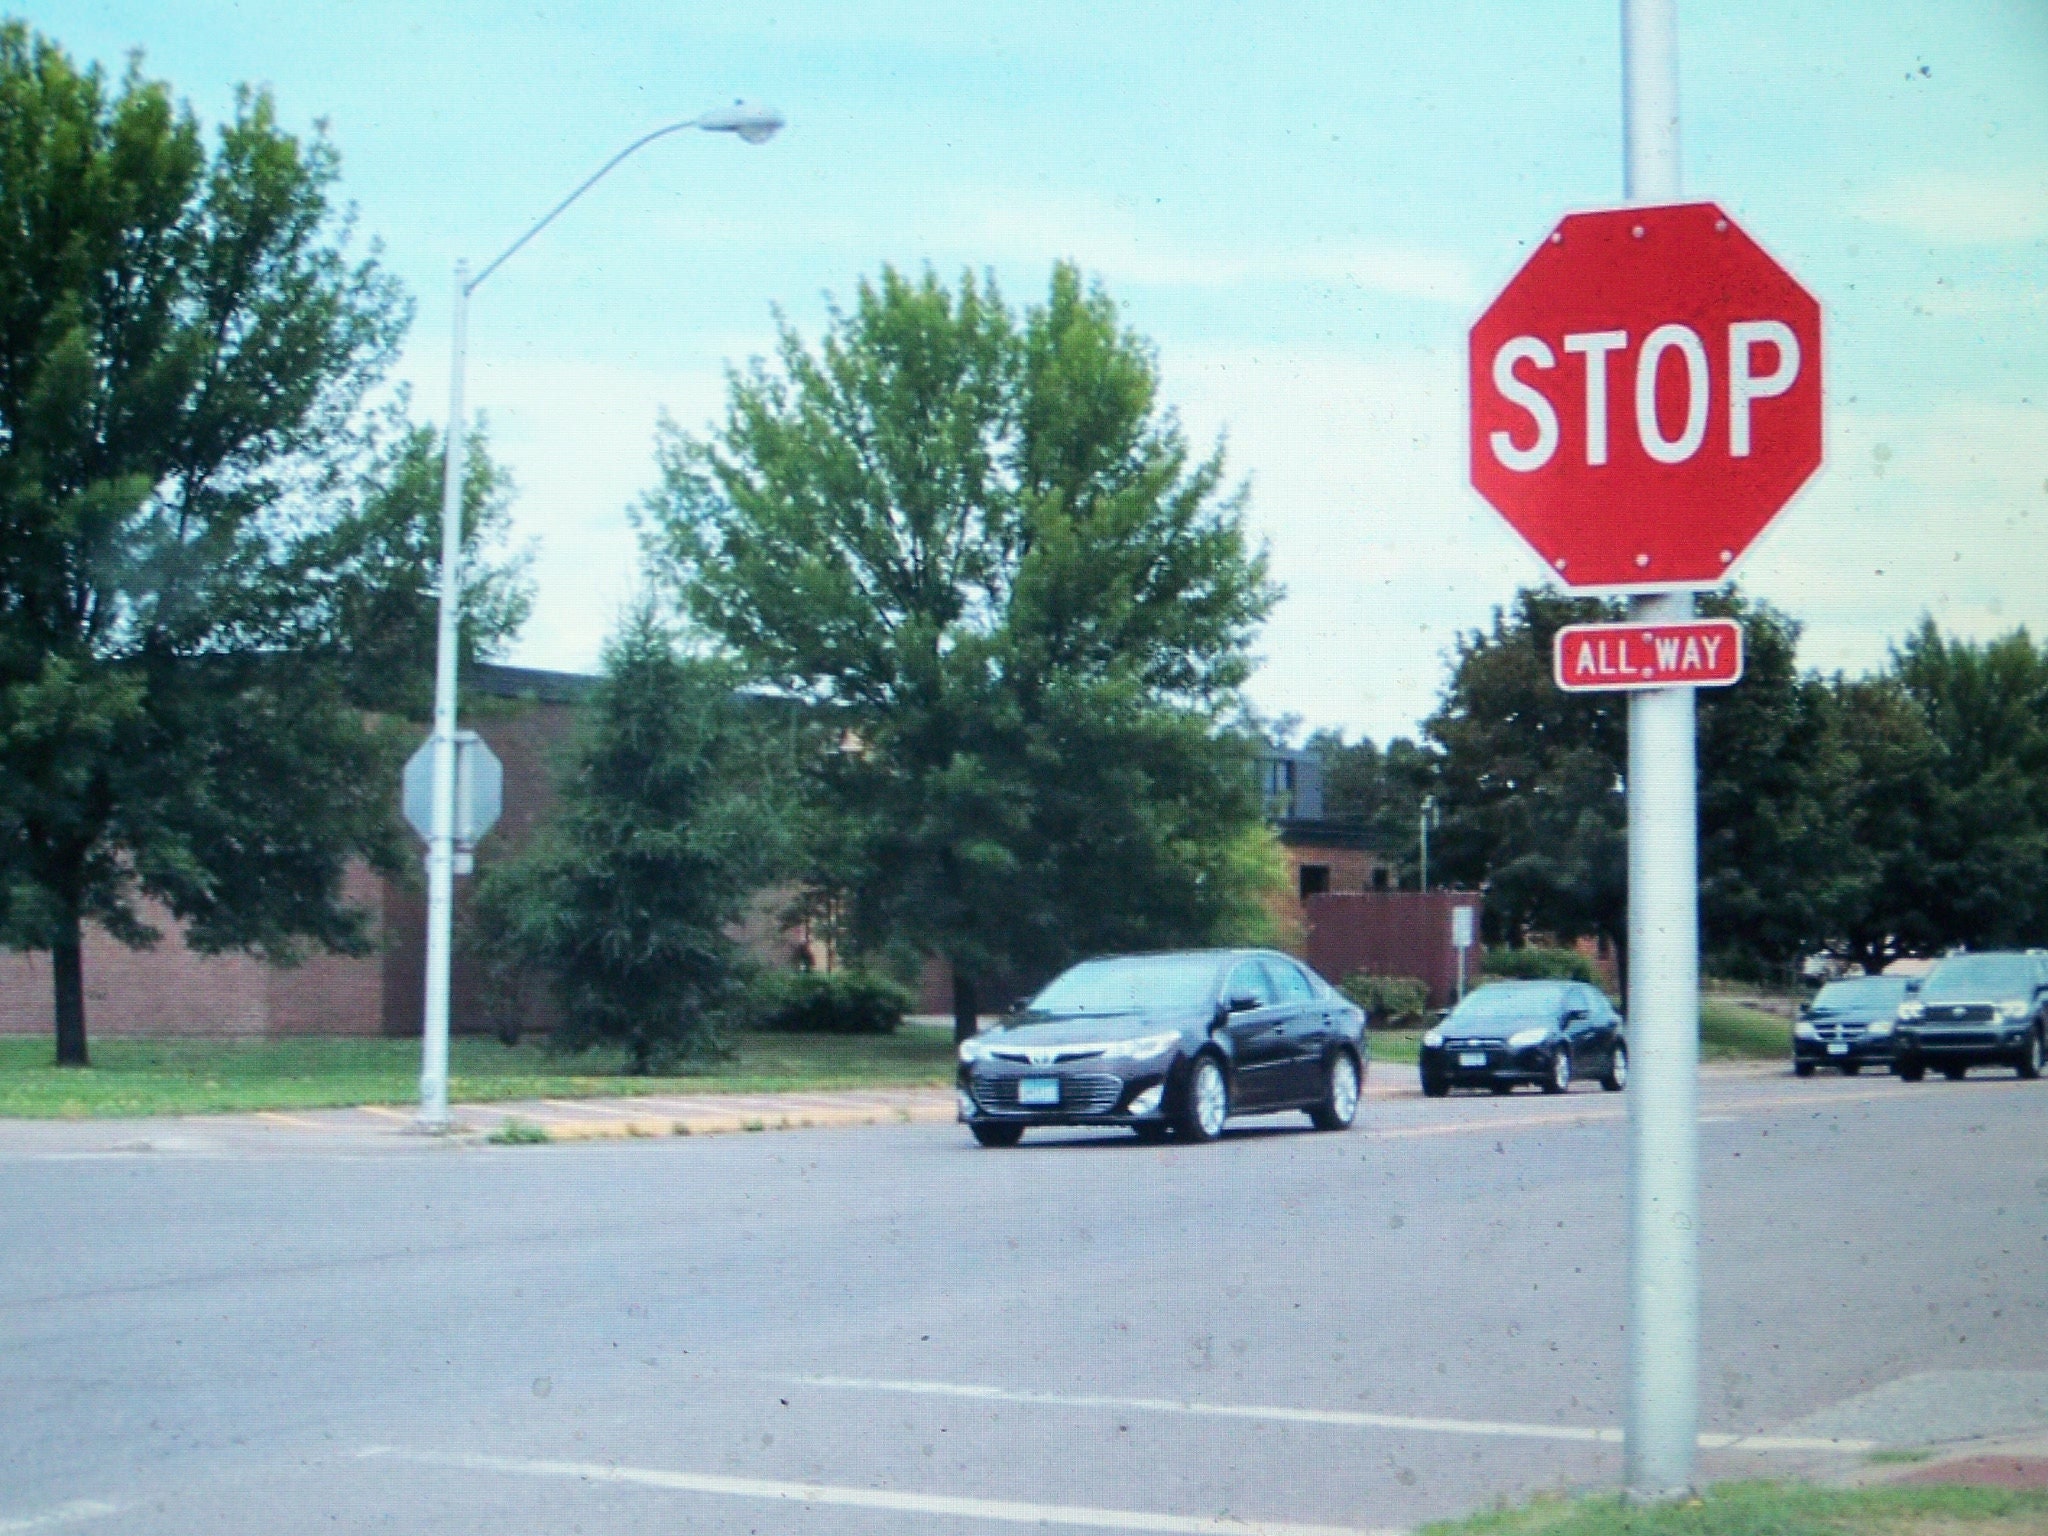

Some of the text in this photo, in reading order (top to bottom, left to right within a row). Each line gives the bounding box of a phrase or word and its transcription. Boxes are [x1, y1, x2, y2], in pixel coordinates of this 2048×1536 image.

[1490, 320, 1801, 472] STOP
[1576, 635, 1722, 675] ALL WAY
